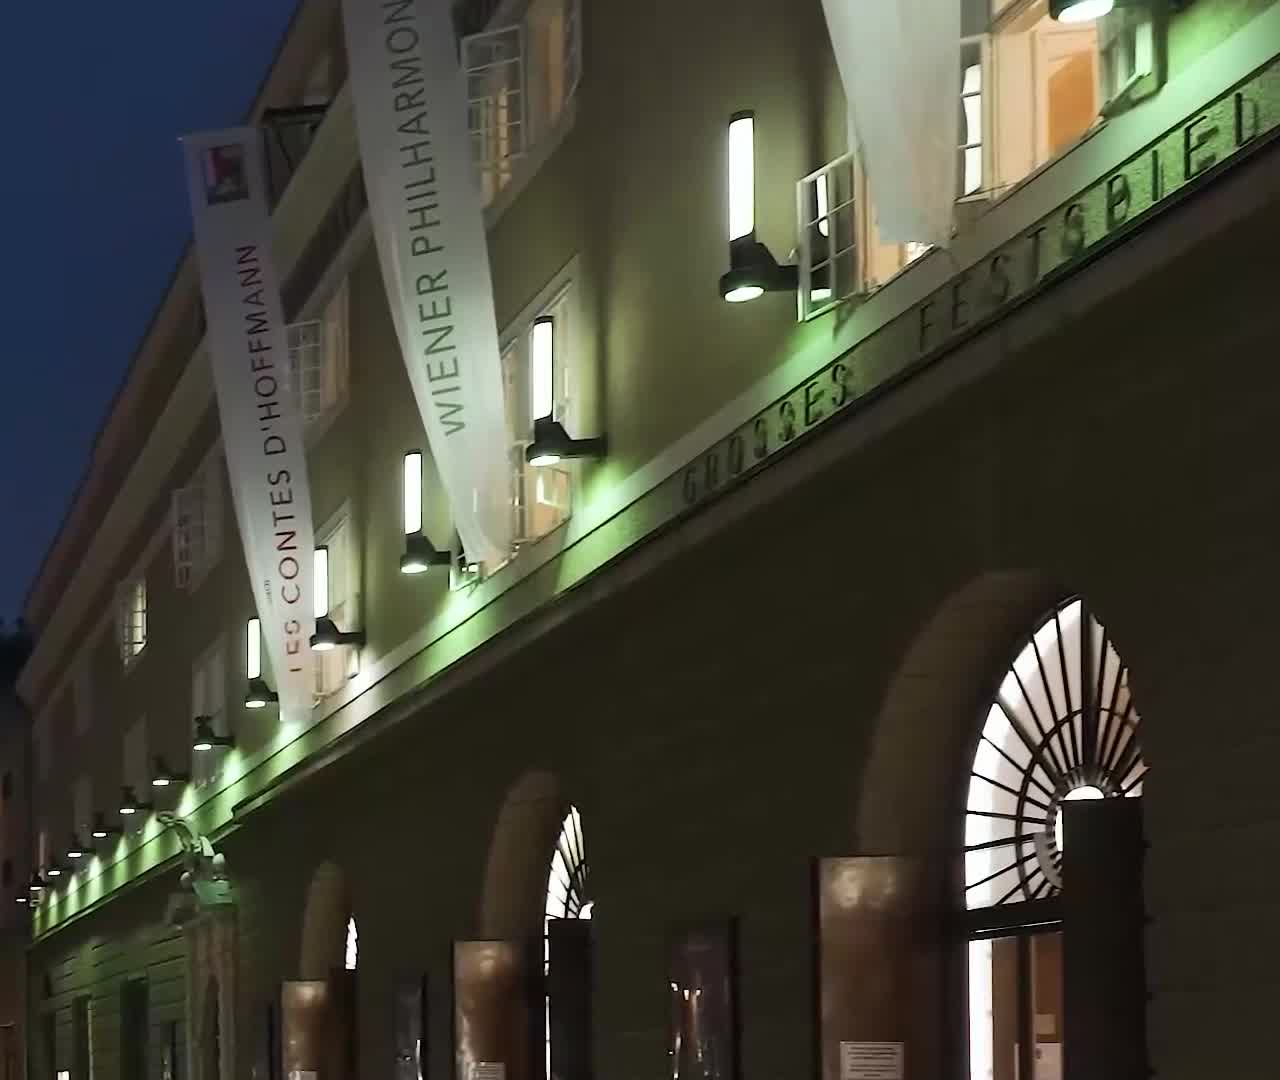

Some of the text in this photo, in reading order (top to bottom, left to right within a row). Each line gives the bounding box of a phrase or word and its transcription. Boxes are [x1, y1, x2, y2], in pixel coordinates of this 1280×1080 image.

[383, 0, 466, 437] WIENER PHILHARMON
[236, 245, 287, 456] D'HOFFMANN
[268, 468, 301, 605] CONTES
